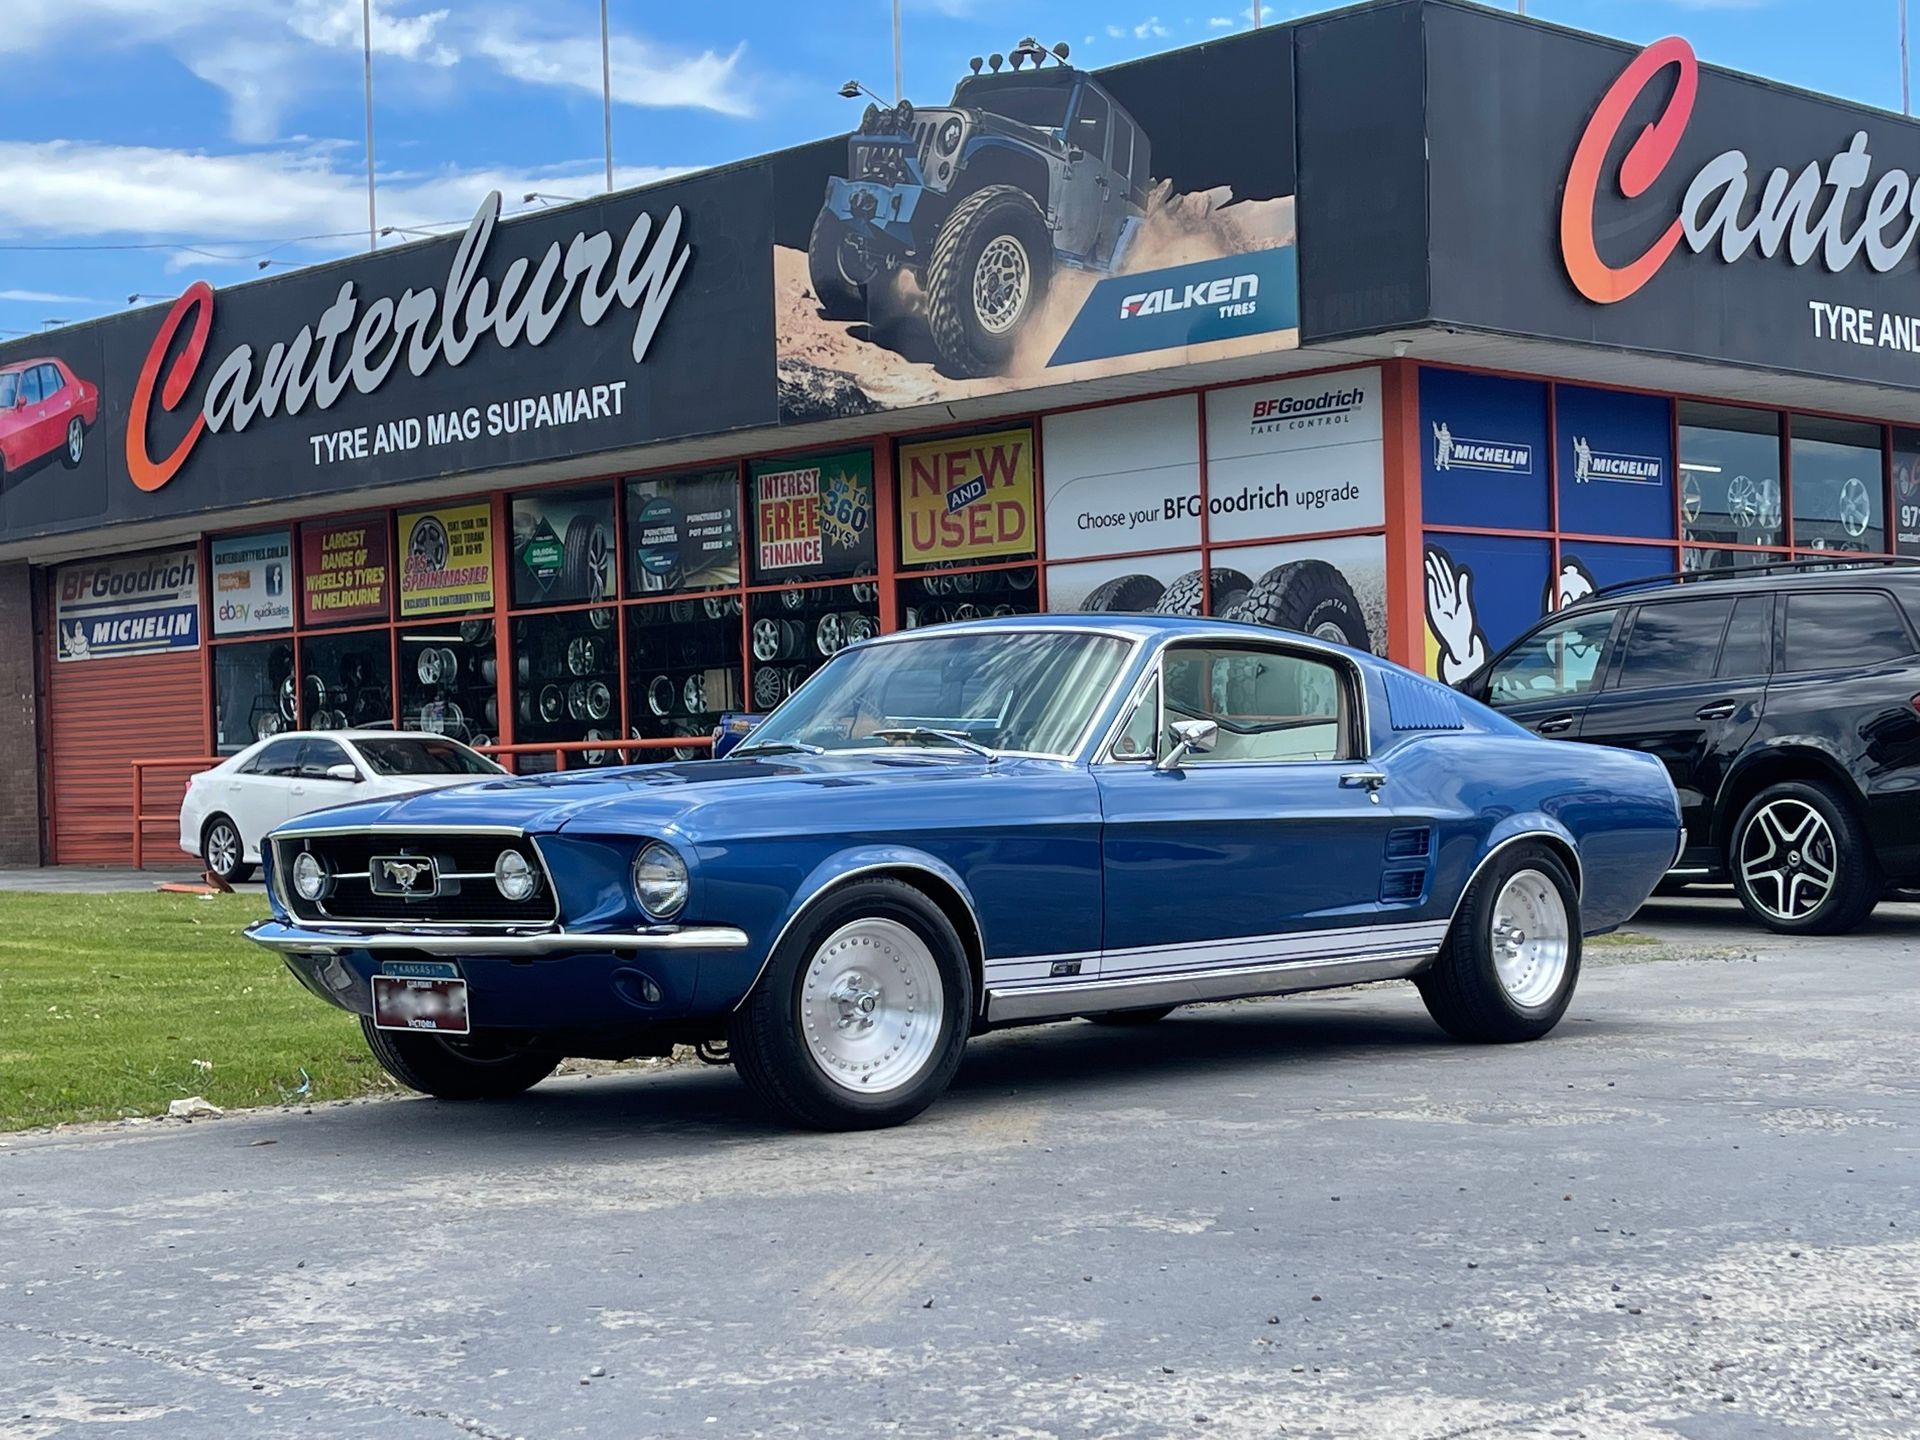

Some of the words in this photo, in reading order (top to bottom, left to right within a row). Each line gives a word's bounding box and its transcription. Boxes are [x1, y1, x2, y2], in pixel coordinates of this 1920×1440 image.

[1561, 35, 1920, 304] Cante
[1120, 273, 1259, 319] FALKEN
[1219, 301, 1256, 319] TYRES
[1809, 301, 1874, 346] TYRE
[125, 190, 691, 492] Canterbury
[1253, 388, 1364, 418] BFGoodrich
[310, 427, 369, 465] TYRE
[373, 418, 421, 455] AND
[427, 407, 481, 445] MAG
[487, 381, 626, 436] SUPAMART
[1250, 423, 1280, 435] TAKE
[1289, 415, 1349, 430] CONTROL
[1454, 444, 1529, 465] MICHELIN
[1593, 458, 1659, 477] MICHELIN
[760, 470, 819, 500] INTEREST
[909, 442, 1023, 499] NEW
[852, 489, 867, 506] TO
[951, 481, 982, 508] AND
[1077, 512, 1126, 531] Choose
[1128, 508, 1161, 530] your
[1164, 483, 1289, 521] BFGoodrich
[1296, 481, 1360, 510] upgrade
[761, 498, 820, 543] FREE
[824, 490, 868, 533] 360
[910, 500, 1026, 552] USED
[1901, 505, 1920, 528] 97
[322, 529, 366, 551] LARGEST
[761, 540, 821, 567] FINANCE
[321, 551, 354, 571] RANGE
[354, 549, 368, 566] OF
[62, 555, 196, 602] BFGoodrich
[306, 571, 344, 592] WHEELS
[354, 566, 385, 587] TYRES
[402, 566, 489, 593] SPRINTMASTER
[312, 594, 322, 611] IN
[323, 587, 381, 610] MELBOURNE
[92, 612, 192, 644] MICHELIN
